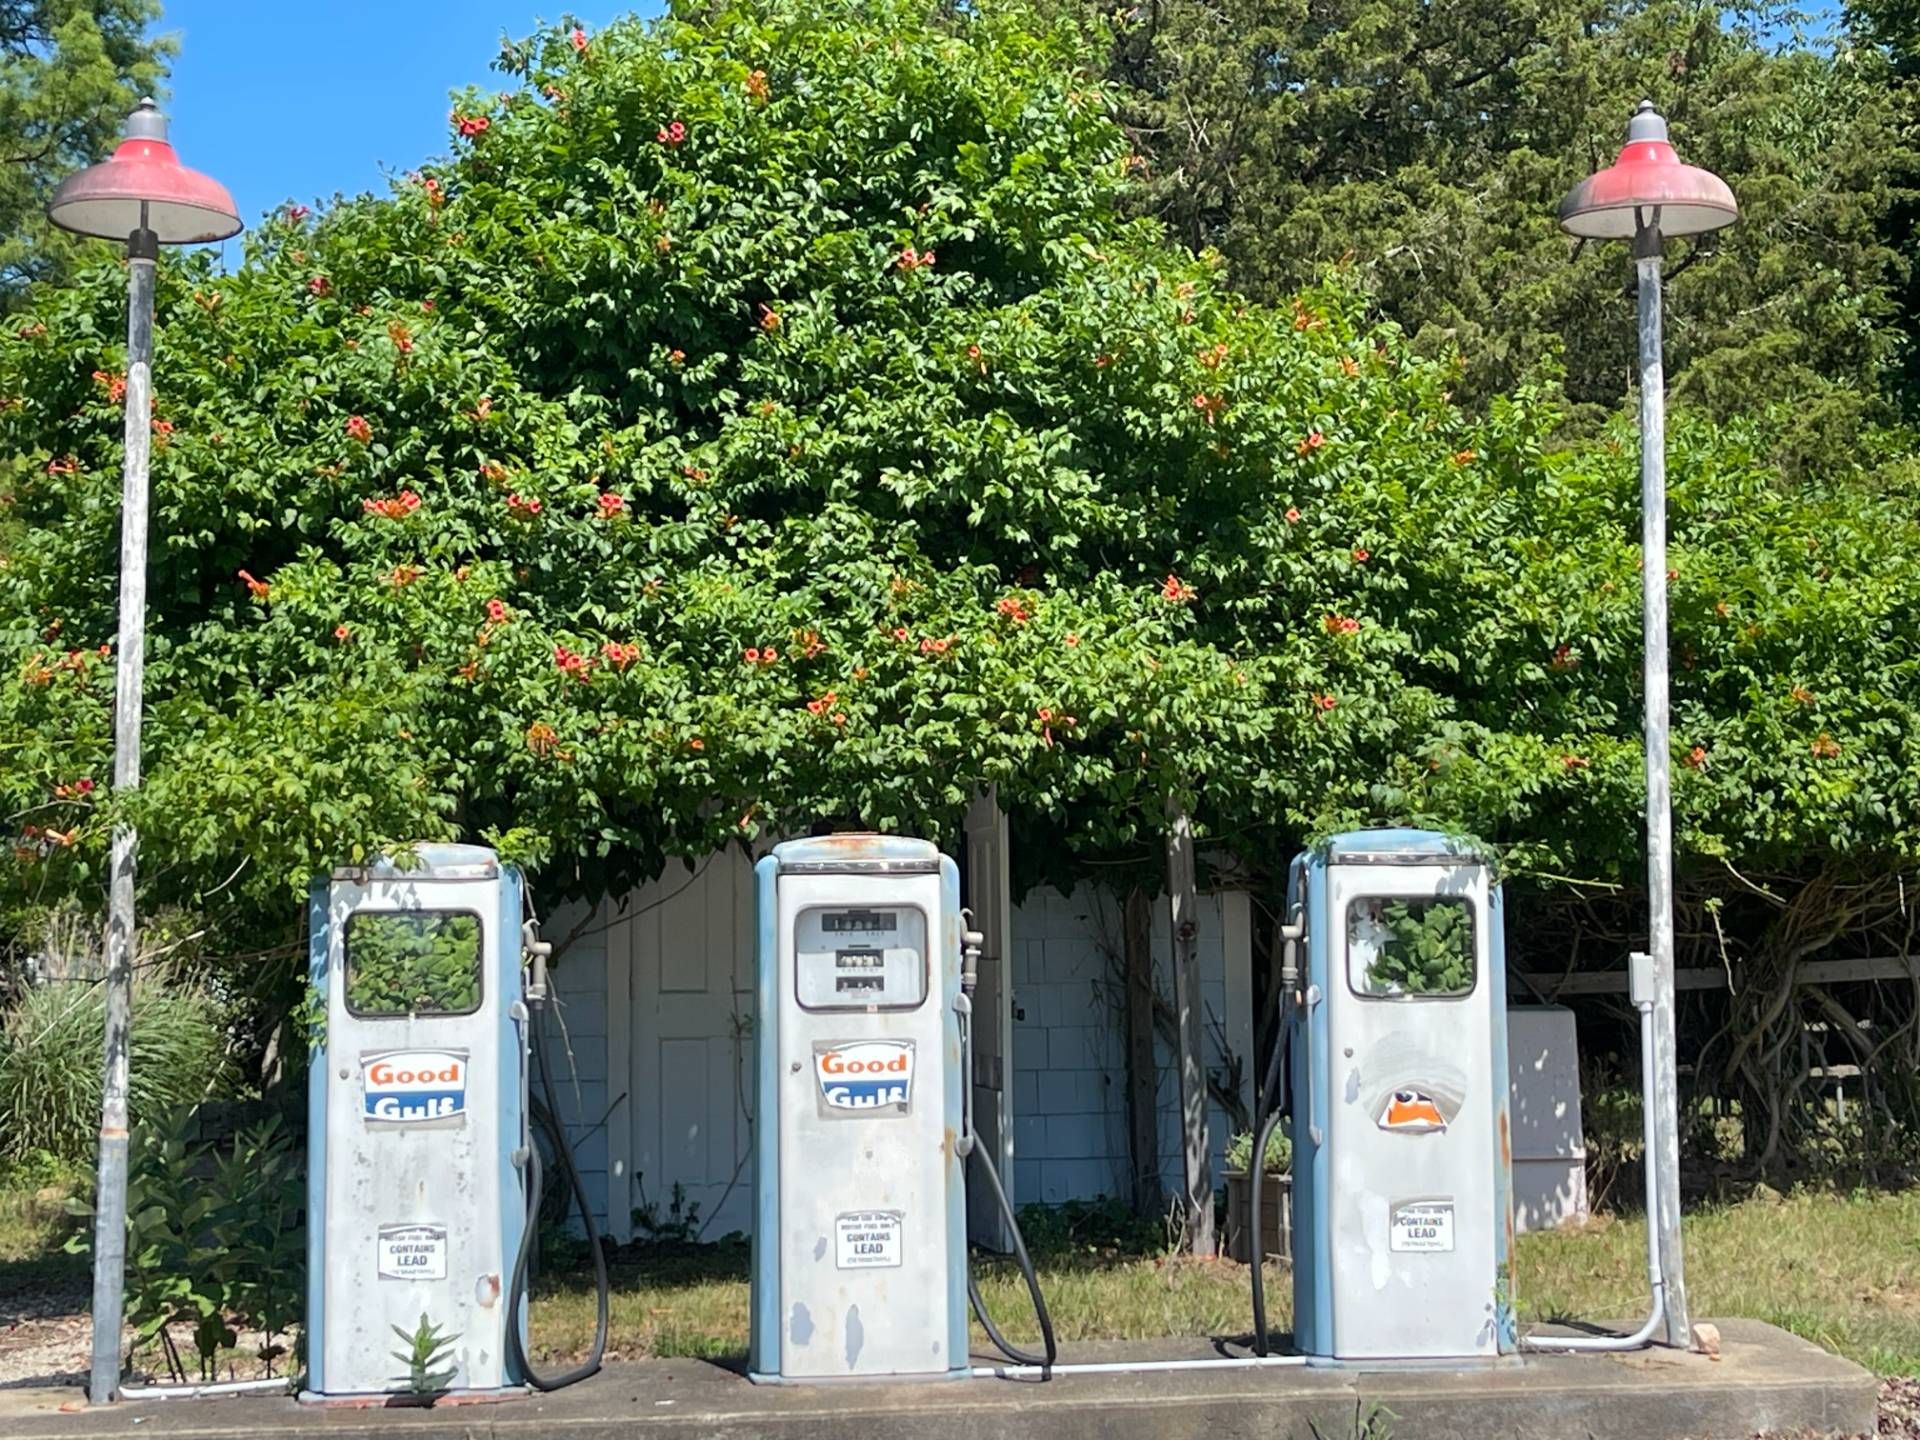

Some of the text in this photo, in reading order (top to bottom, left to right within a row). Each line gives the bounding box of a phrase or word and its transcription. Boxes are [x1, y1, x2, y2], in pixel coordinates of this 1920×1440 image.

[821, 1052, 907, 1074] Good
[370, 1063, 458, 1086] Good
[827, 1087, 904, 1106] Gulf
[375, 1097, 455, 1119] Gulf
[1400, 1217, 1443, 1227] CONTAINS
[847, 1232, 890, 1242] CONTAINS
[1407, 1227, 1437, 1238] LEAD
[390, 1245, 435, 1254] CONTAINS
[854, 1243, 884, 1254] LEAD
[397, 1255, 428, 1266] LEAD
